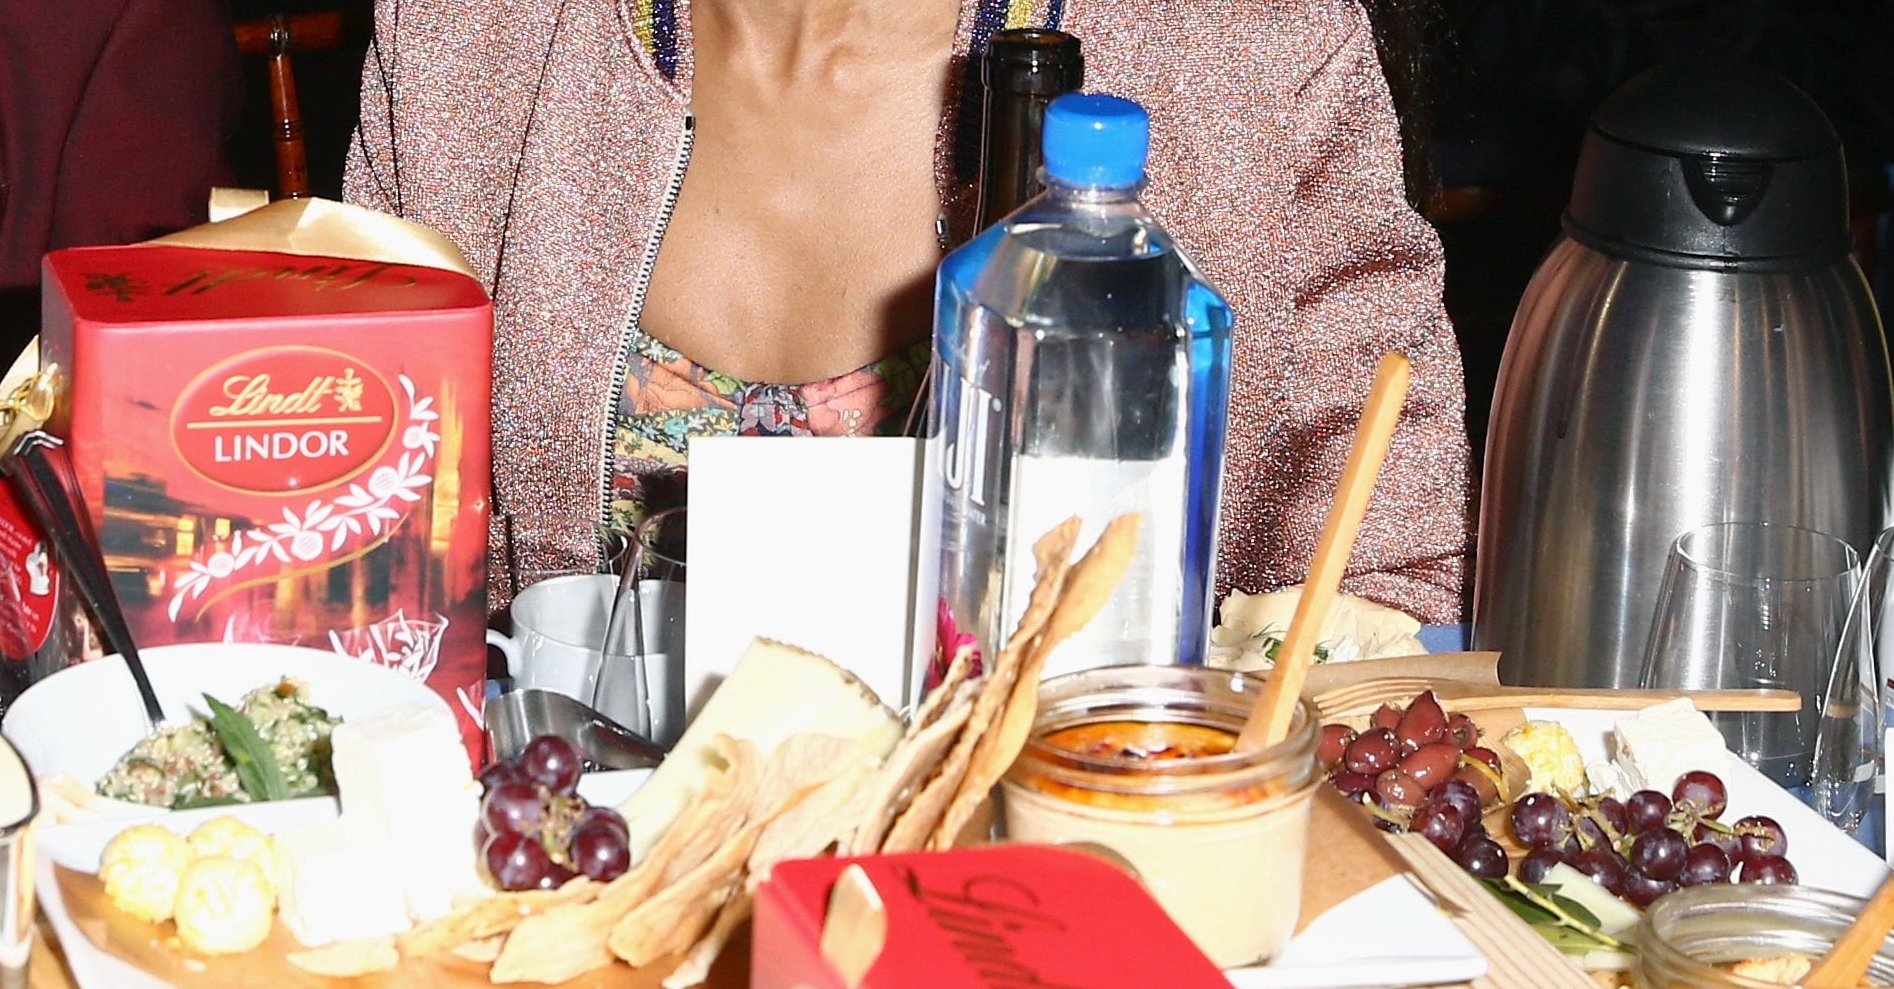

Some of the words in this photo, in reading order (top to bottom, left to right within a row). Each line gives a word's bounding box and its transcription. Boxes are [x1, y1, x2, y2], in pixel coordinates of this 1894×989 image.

[209, 374, 335, 416] Lindt
[215, 430, 349, 462] LINDOR
[889, 862, 1088, 989] Lind
